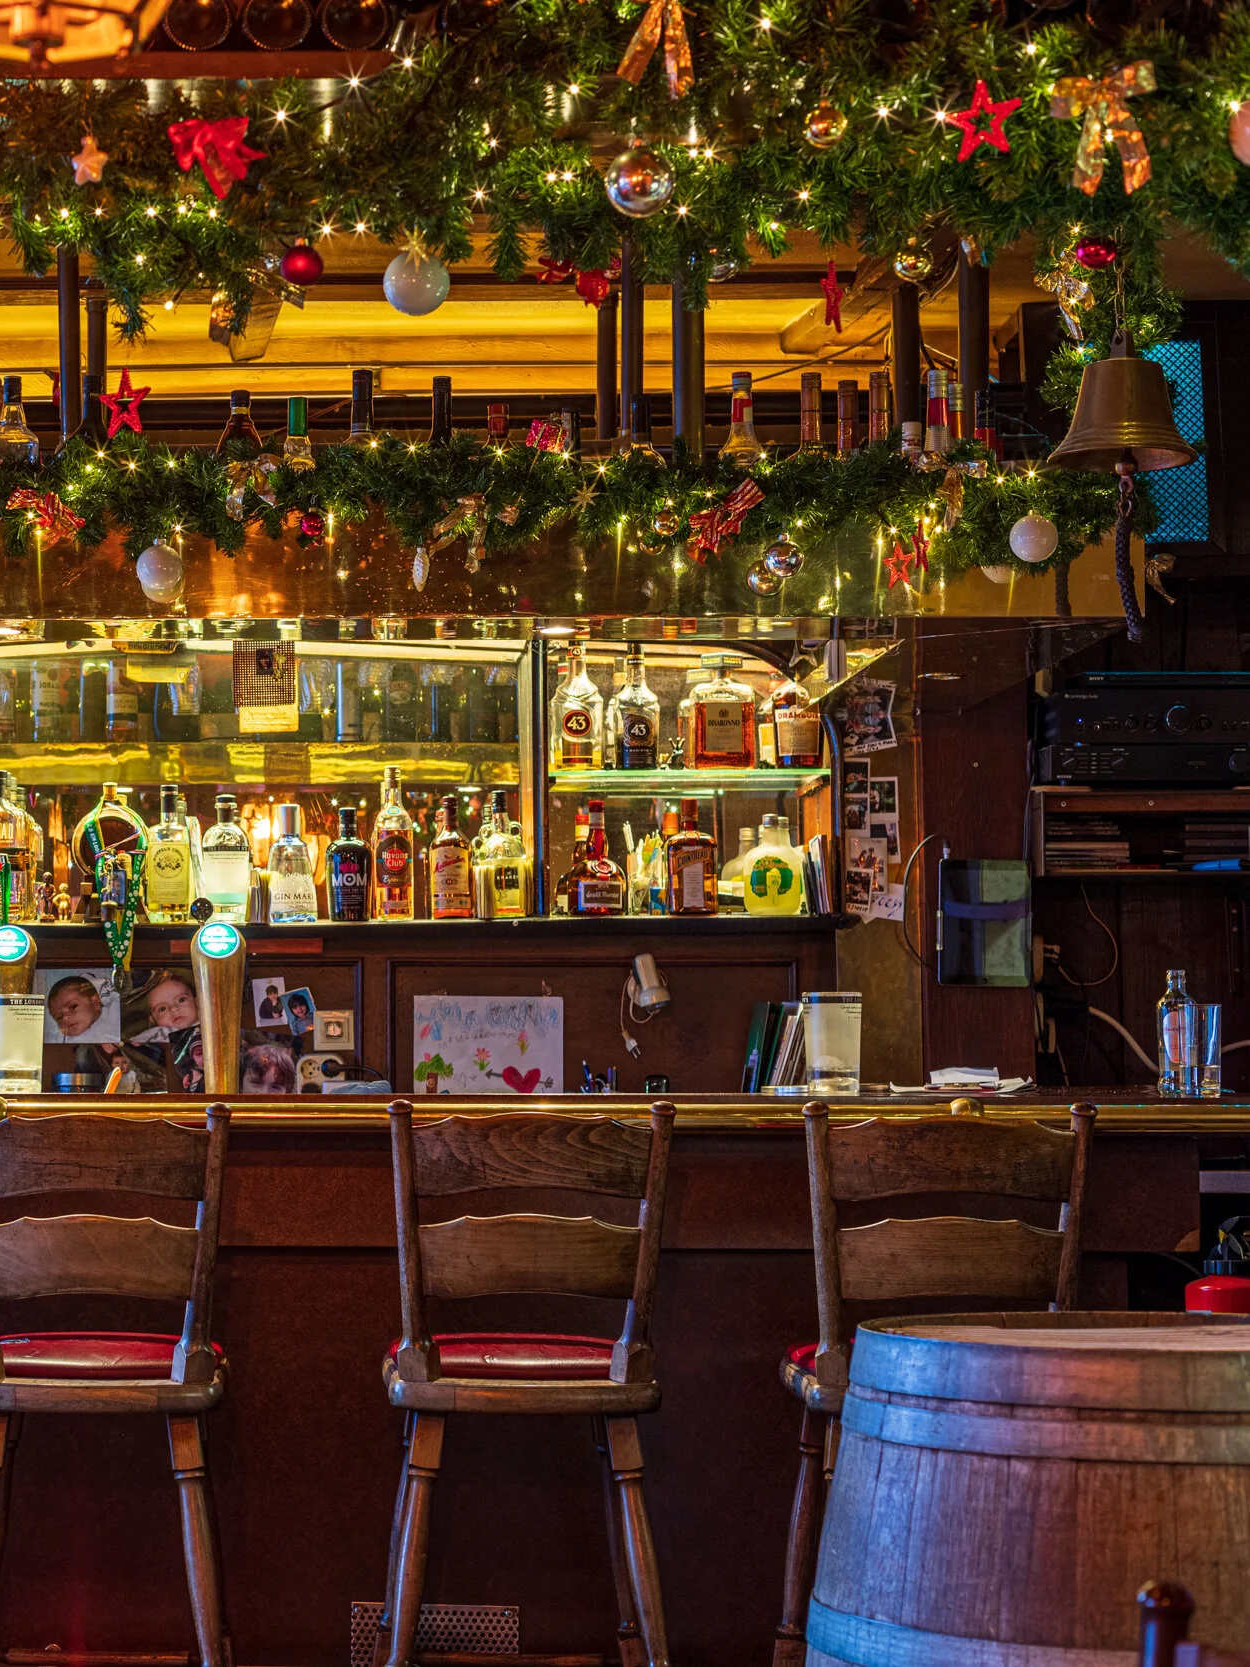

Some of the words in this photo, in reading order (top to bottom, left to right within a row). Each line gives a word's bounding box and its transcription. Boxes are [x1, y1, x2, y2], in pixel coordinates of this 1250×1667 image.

[572, 647, 581, 655] 43
[567, 716, 586, 730] 43
[707, 719, 741, 727] DISARONNO
[630, 724, 647, 736] 43
[381, 850, 409, 860] Havana
[386, 859, 404, 867] Club
[331, 873, 368, 887] MOM
